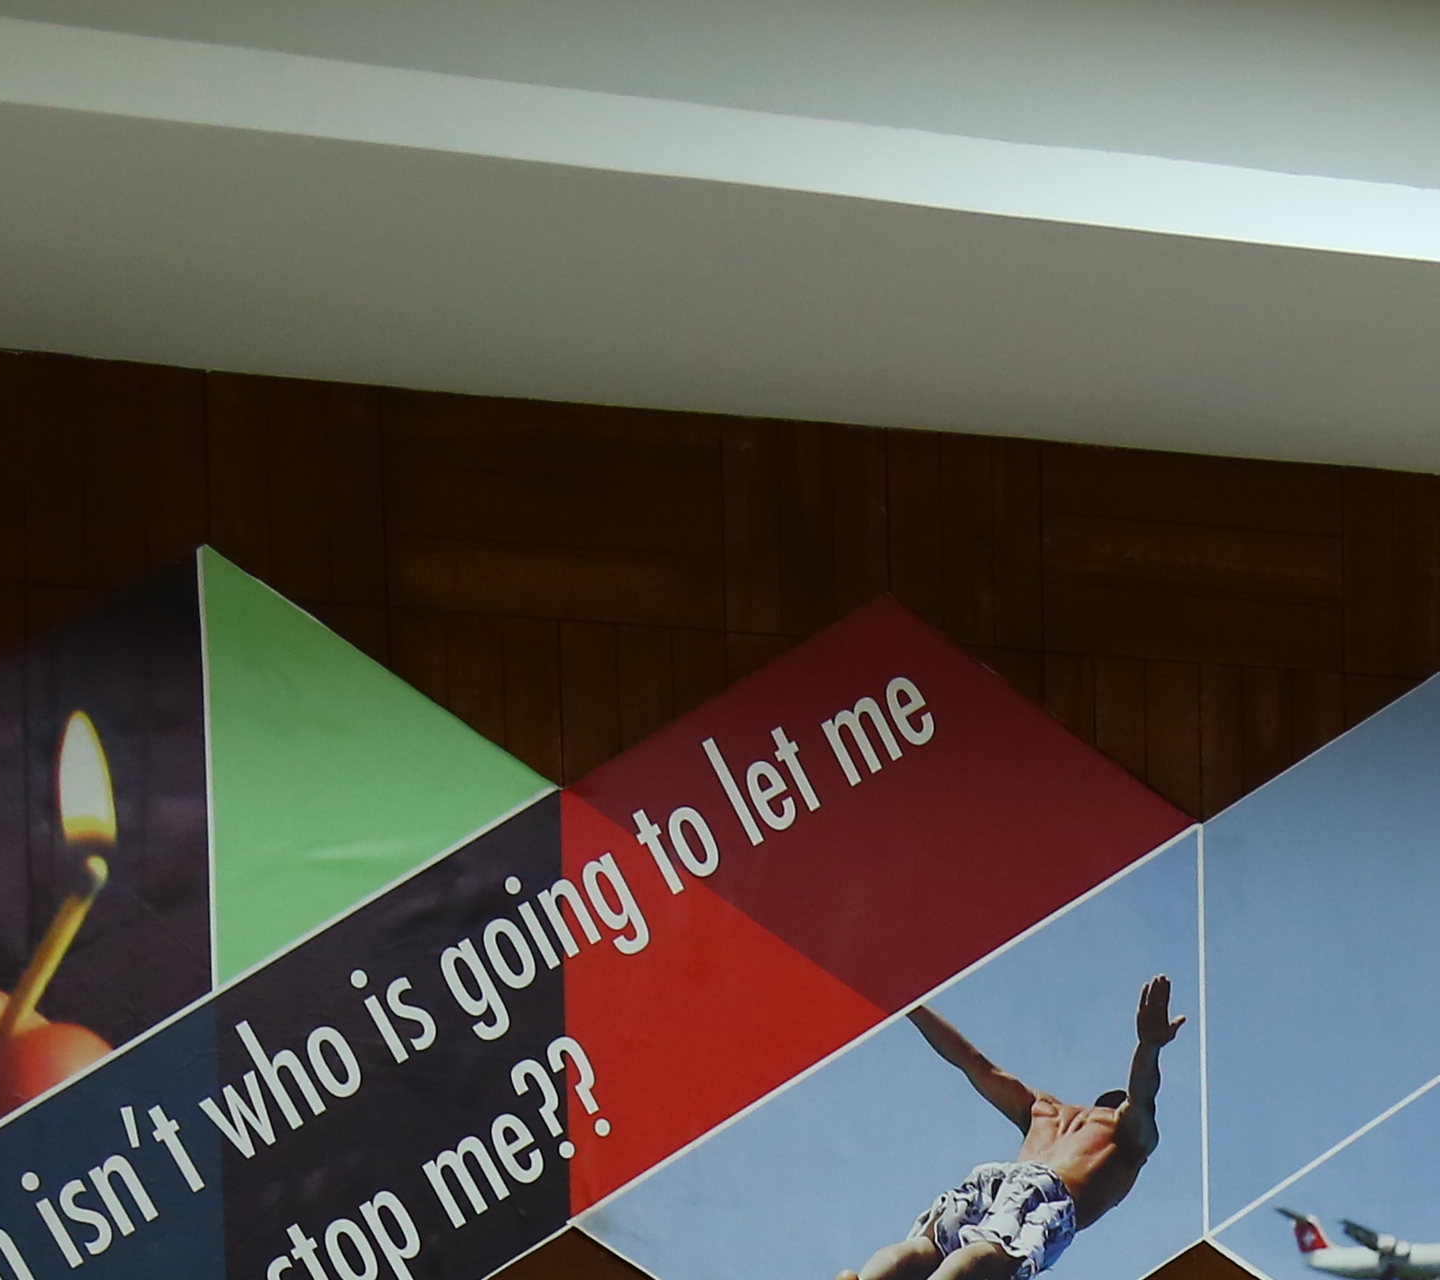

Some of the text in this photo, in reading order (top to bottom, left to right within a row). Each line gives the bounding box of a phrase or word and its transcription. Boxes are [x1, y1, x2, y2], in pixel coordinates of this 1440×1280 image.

[21, 1104, 205, 1269] isn't
[198, 1019, 362, 1159] who
[350, 969, 437, 1064] is
[440, 852, 650, 1041] going
[632, 808, 719, 895] to
[701, 737, 821, 847] let
[821, 677, 935, 787] me
[421, 1036, 611, 1229] me??
